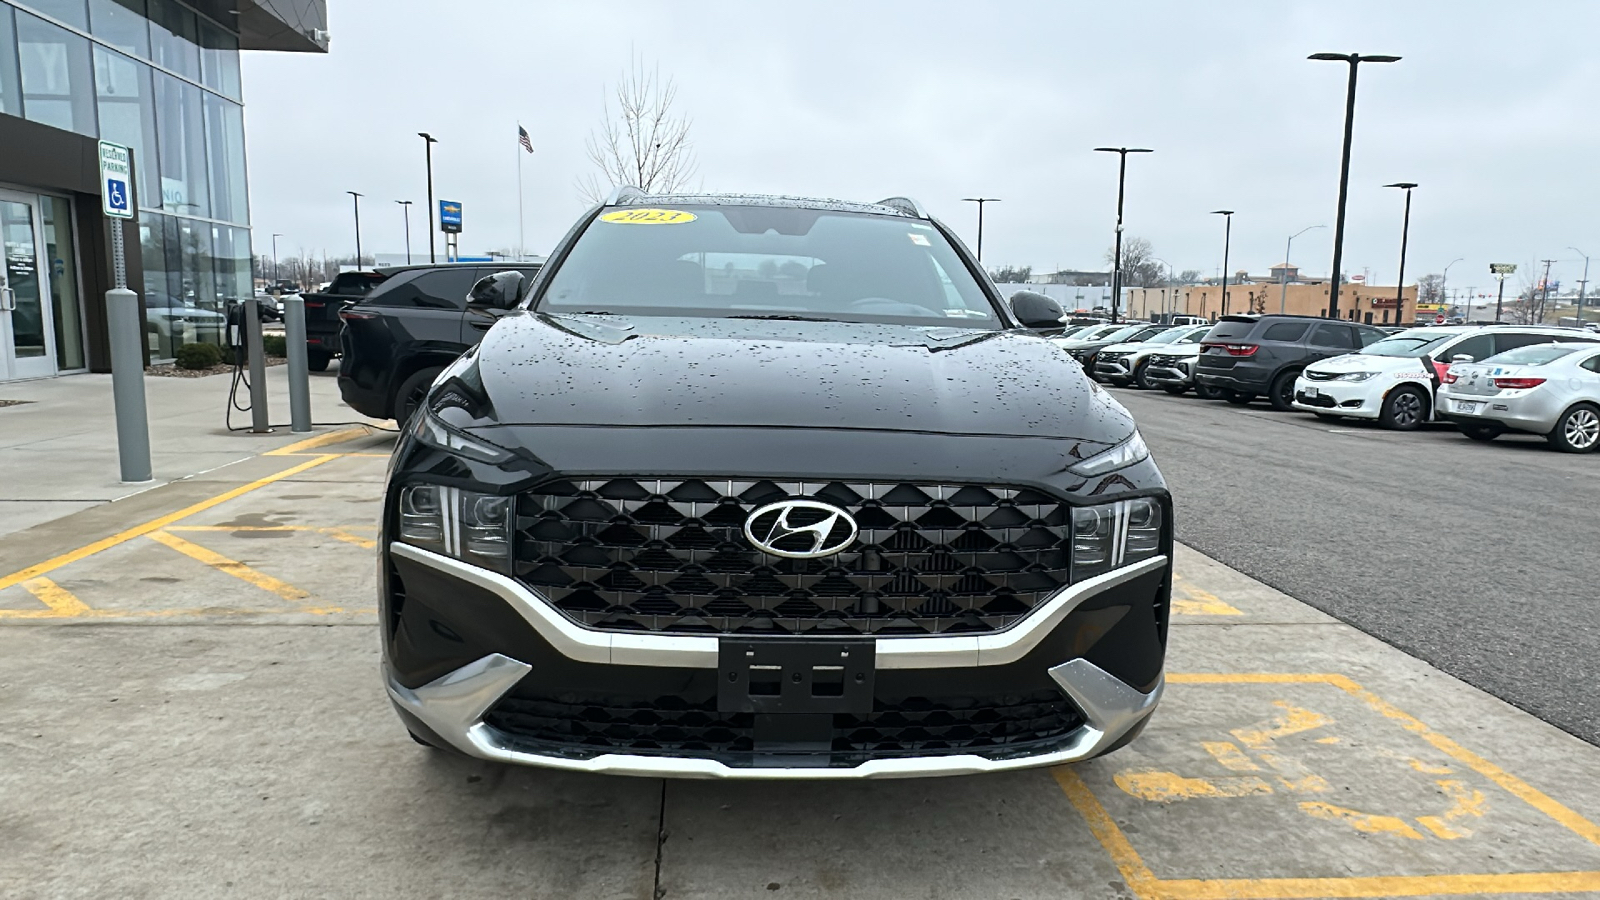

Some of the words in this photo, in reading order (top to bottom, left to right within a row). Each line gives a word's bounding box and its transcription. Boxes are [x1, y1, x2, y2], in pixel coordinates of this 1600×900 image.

[102, 148, 126, 162] RESERVED
[103, 161, 127, 174] PARKING
[613, 211, 682, 221] 2023
